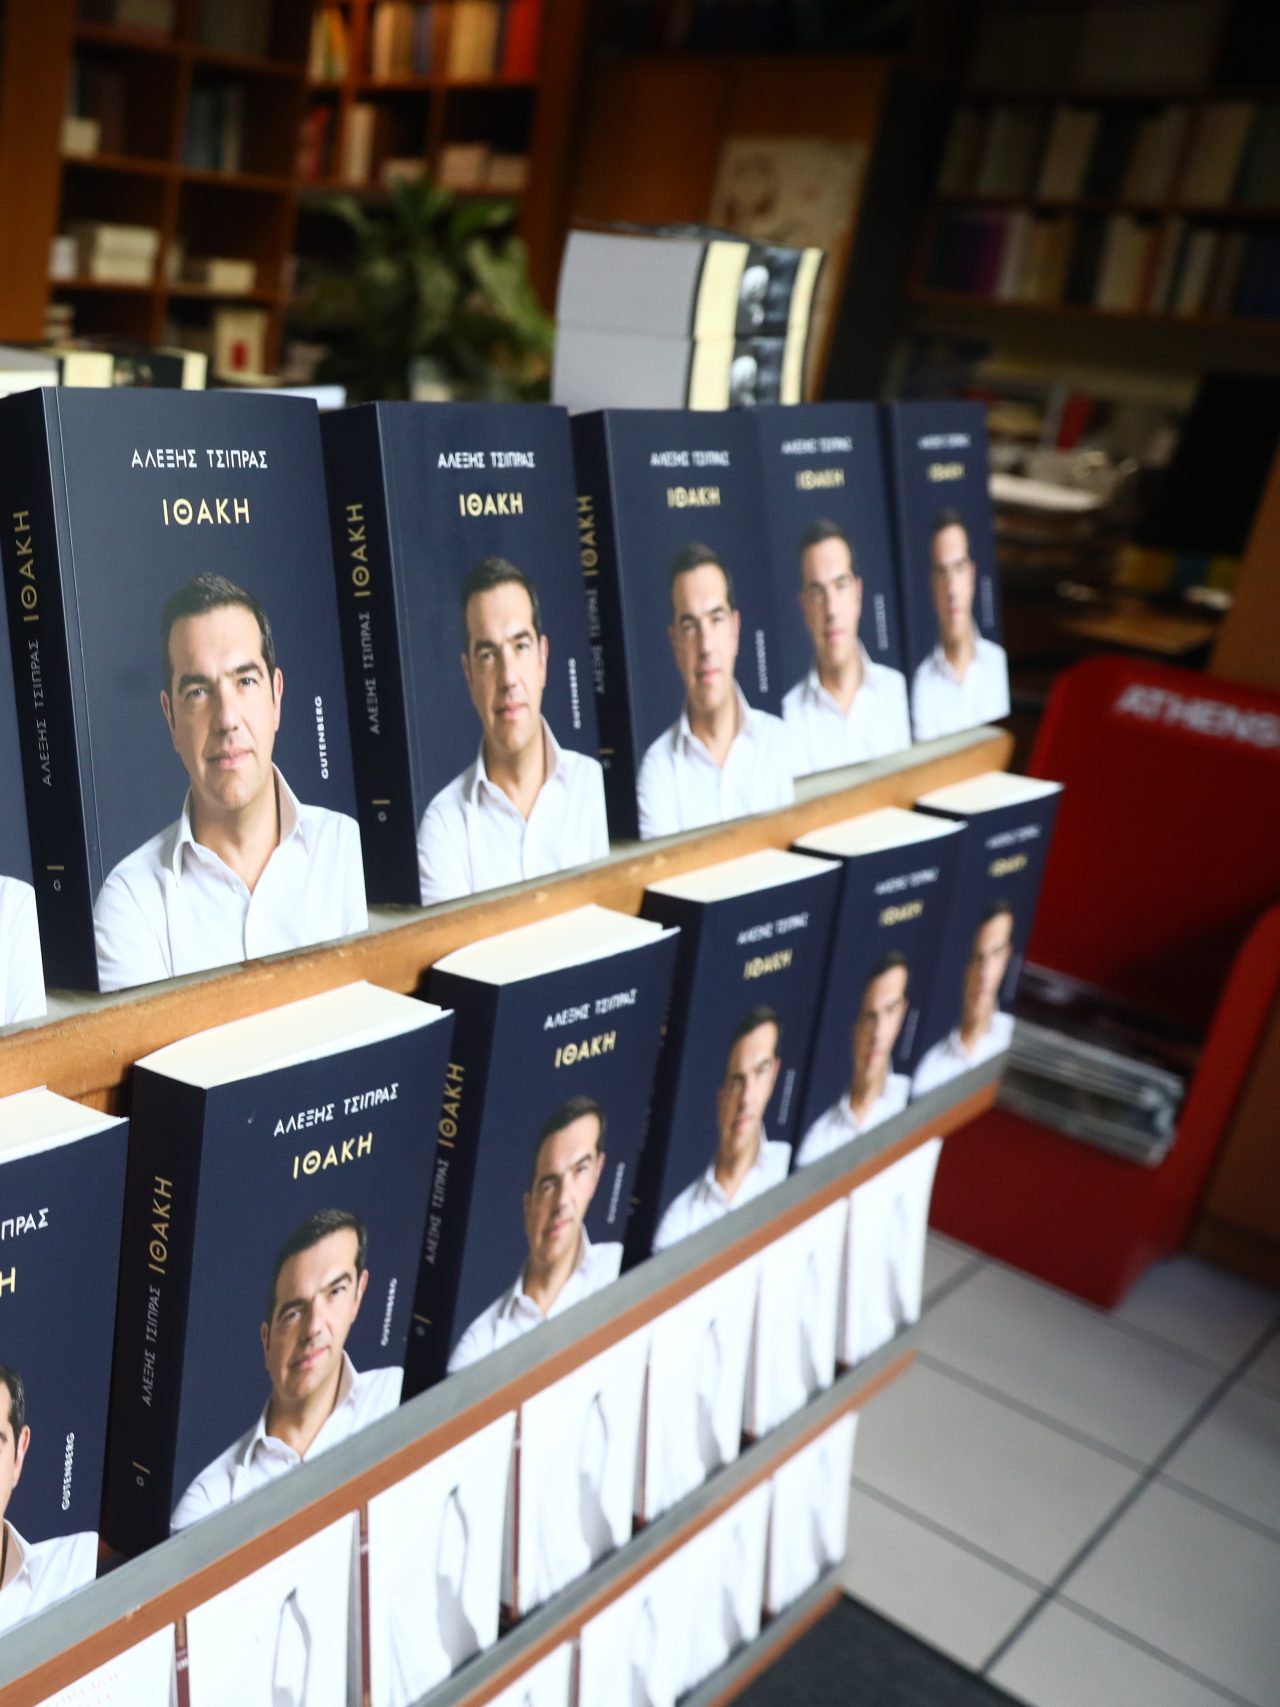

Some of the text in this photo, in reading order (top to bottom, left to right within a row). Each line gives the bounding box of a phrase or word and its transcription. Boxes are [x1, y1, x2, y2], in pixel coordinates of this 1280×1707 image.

[131, 448, 268, 469] ΑΛΕΞΗΣ ΤΣΙΠΡΑΣ
[438, 451, 535, 469] ΑΛΕΞΗΣ ΤΣΙΠΡΑΣ
[162, 497, 250, 526] ΙΘΑΚΗ
[459, 492, 524, 517] ΙΘΑΚΗ
[666, 486, 720, 508] ΙΘΑΚΗ
[346, 503, 371, 598] ΙΘΑΚΗ
[576, 495, 599, 577] ΙΘΑΚΗ
[13, 510, 39, 622] ΙΘΑΚΗ
[358, 611, 375, 669] ΤΣΙΠΡΑΣ
[28, 639, 53, 787] ΑΛΕΞΗΣ ΤΣΙΠΡΑΣ
[315, 696, 329, 780] GUTENBERG
[543, 1003, 590, 1030] ΑΛΕΞΗΣ
[554, 1030, 617, 1069] ΙΘΑΚΗ
[273, 1082, 399, 1137] ΑΛΕΞΗΣ ΤΣΙΠΡΑΣ
[437, 1062, 465, 1148] ΙΘΑΚΗ
[293, 1132, 373, 1179] ΙΘΑΚΗ
[148, 1175, 173, 1275] ΙΘΑΚΗ
[141, 1286, 161, 1407] ΑΛΕΞΗΣ ΤΣΙΠΡΑΣ
[61, 1432, 75, 1511] GUTENBERG
